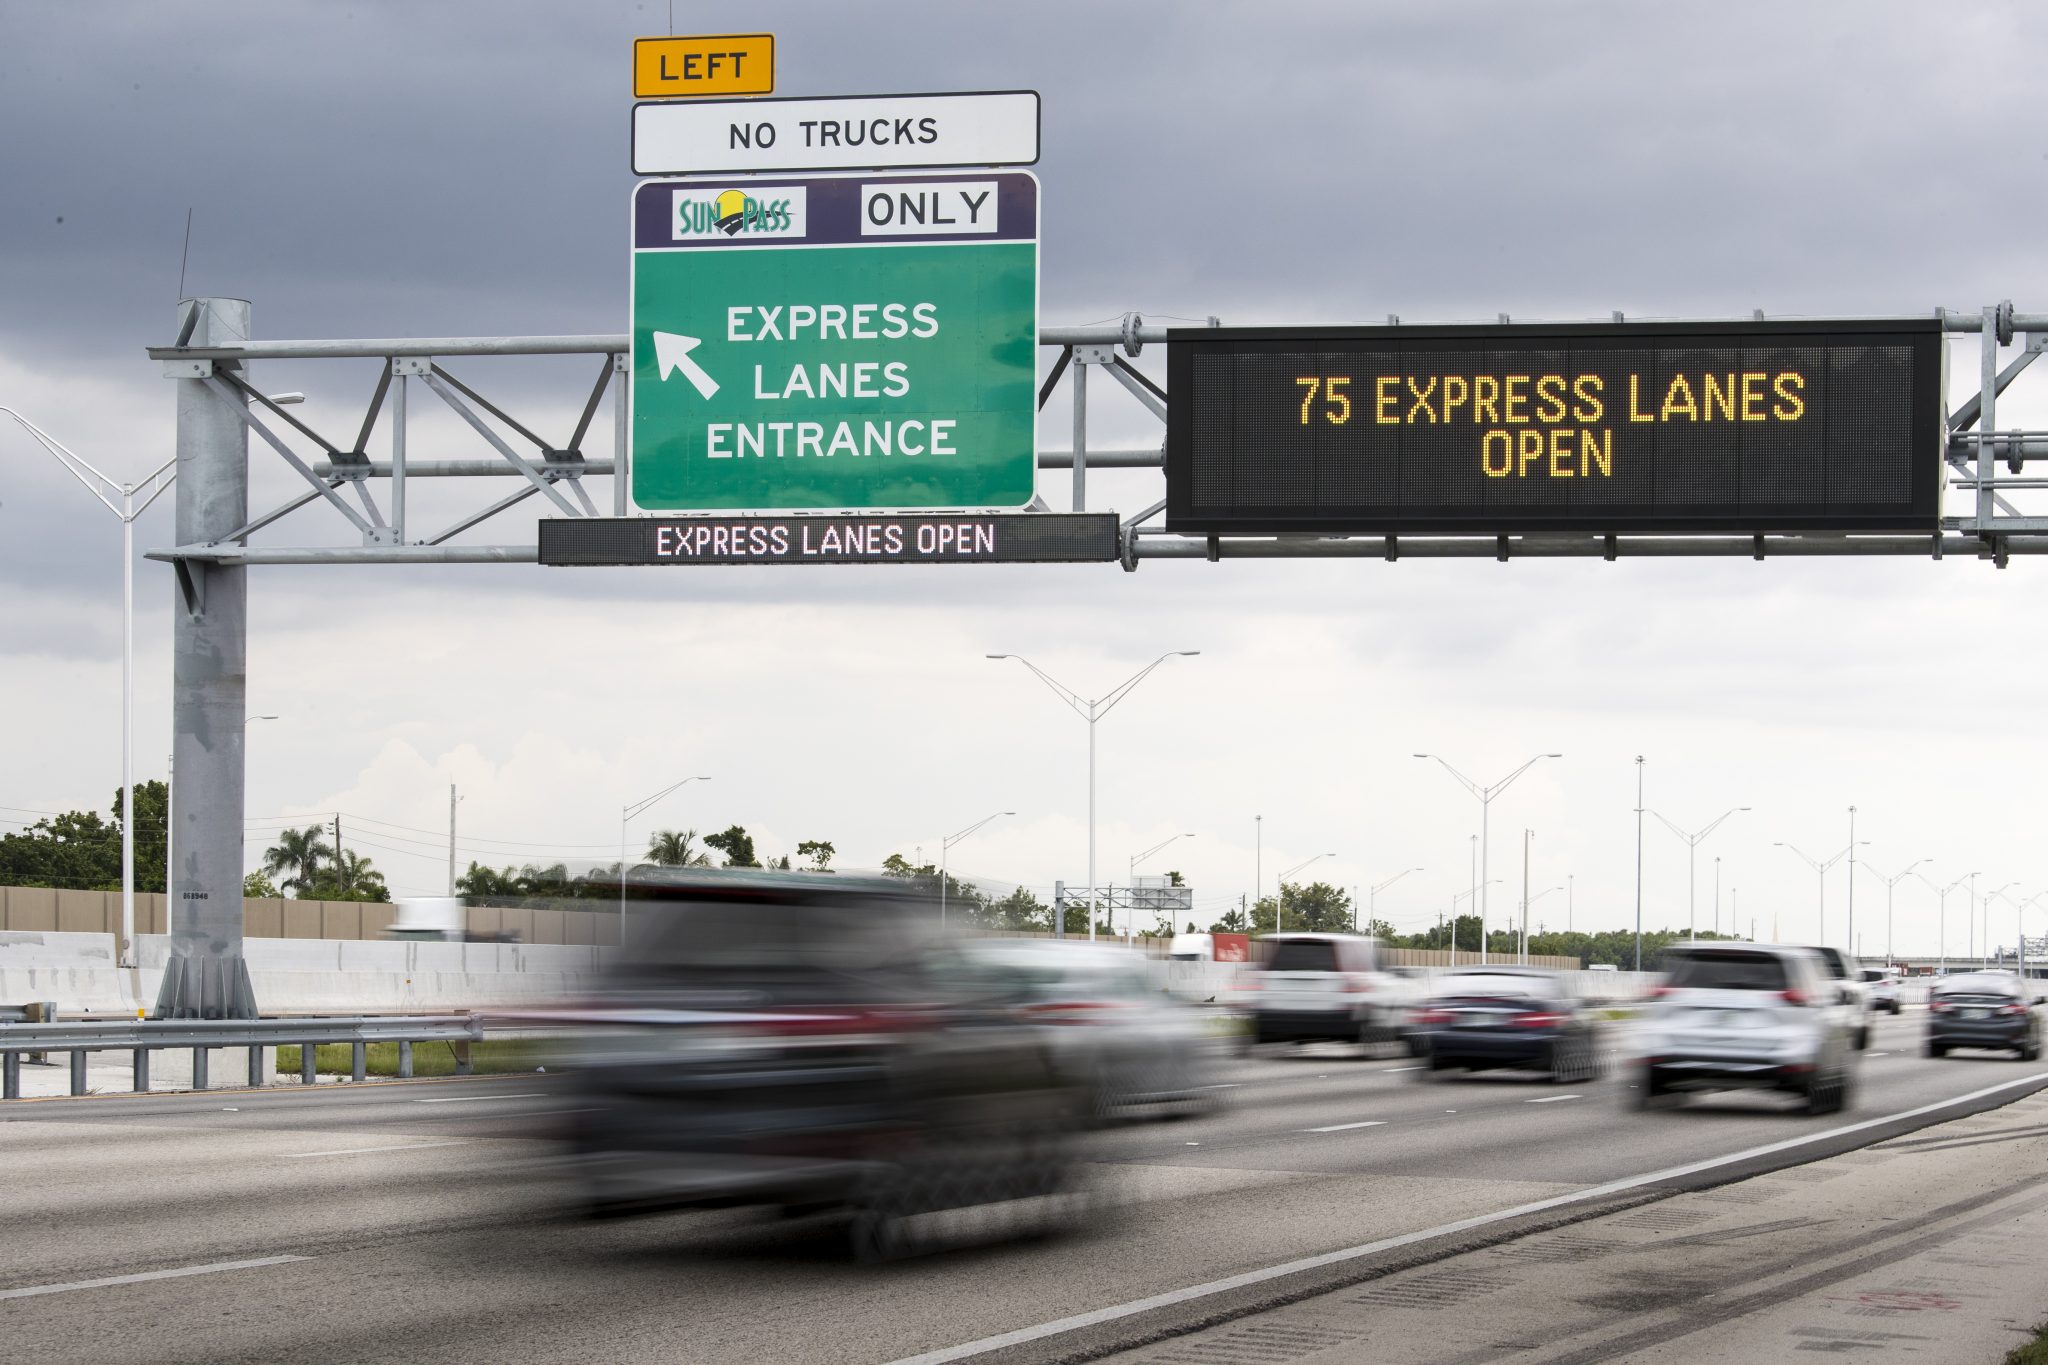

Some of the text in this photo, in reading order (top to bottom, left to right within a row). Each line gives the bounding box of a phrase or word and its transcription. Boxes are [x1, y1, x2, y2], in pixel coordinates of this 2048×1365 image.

[660, 52, 748, 81] LEFT
[729, 117, 938, 150] NO TRUCKS
[868, 191, 990, 226] ONLY
[727, 303, 940, 341] EXPRESS
[754, 362, 910, 400] LANES
[1296, 373, 1805, 425] 75 EXPRESS LANES
[707, 419, 957, 459] ENTRANCE
[1482, 429, 1612, 477] OPEN
[656, 523, 994, 557] EXPRESS LANES OPEN
